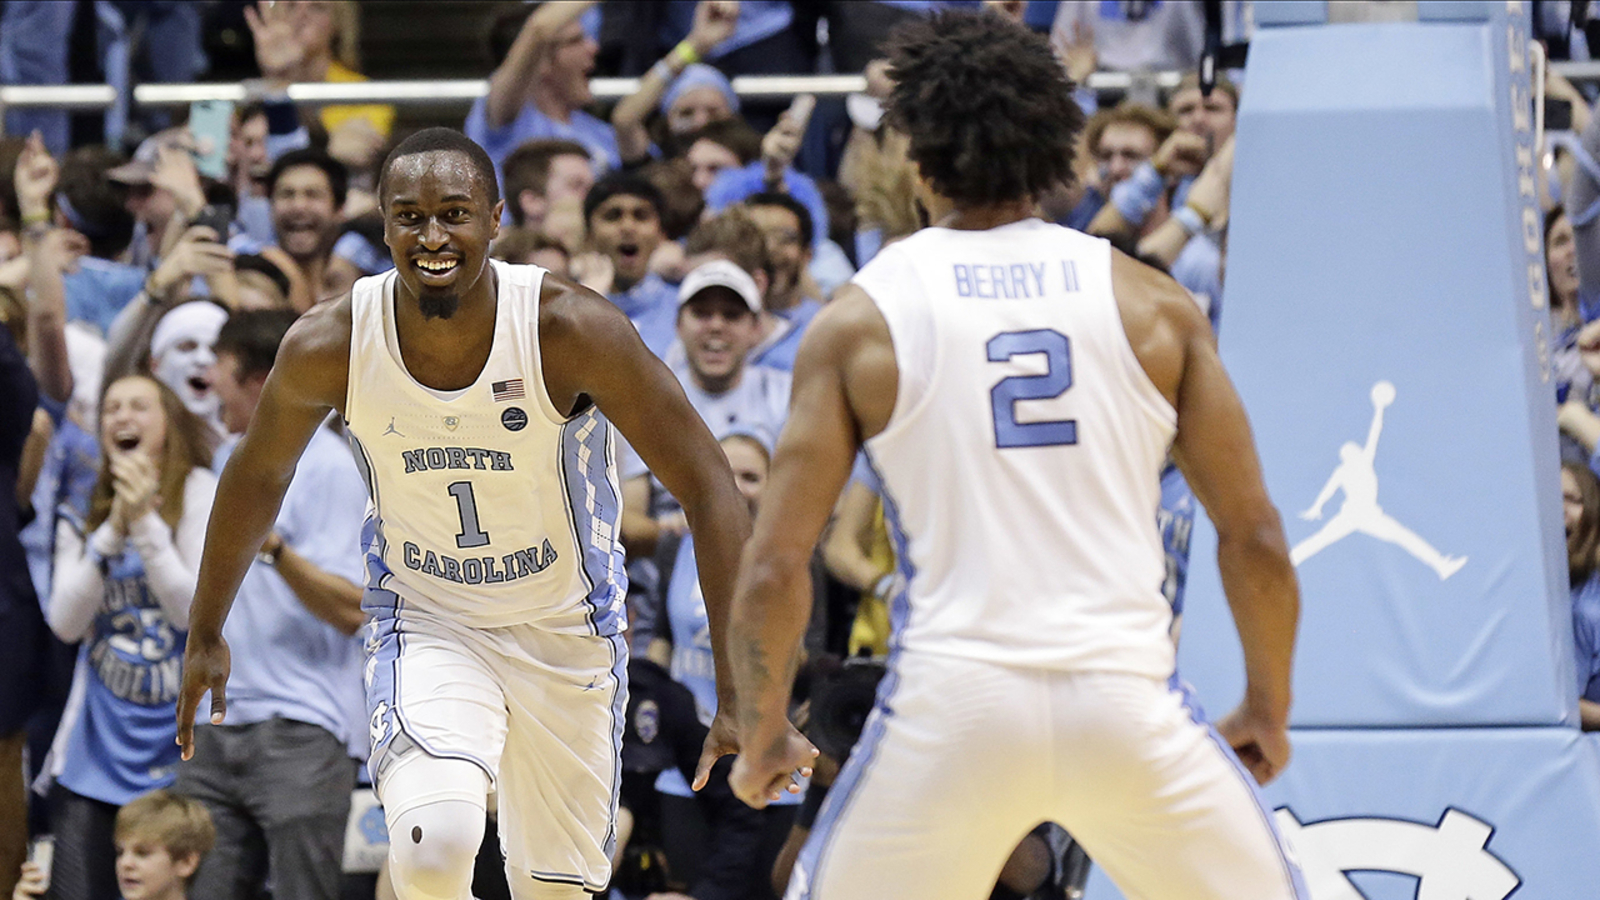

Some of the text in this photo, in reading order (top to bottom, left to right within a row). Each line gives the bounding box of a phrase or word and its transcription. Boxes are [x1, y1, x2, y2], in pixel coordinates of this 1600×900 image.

[953, 259, 1080, 299] BERRY II
[986, 328, 1077, 448] 2
[402, 447, 514, 474] NORTH
[447, 481, 490, 548] 1
[403, 538, 559, 585] CAROLINA
